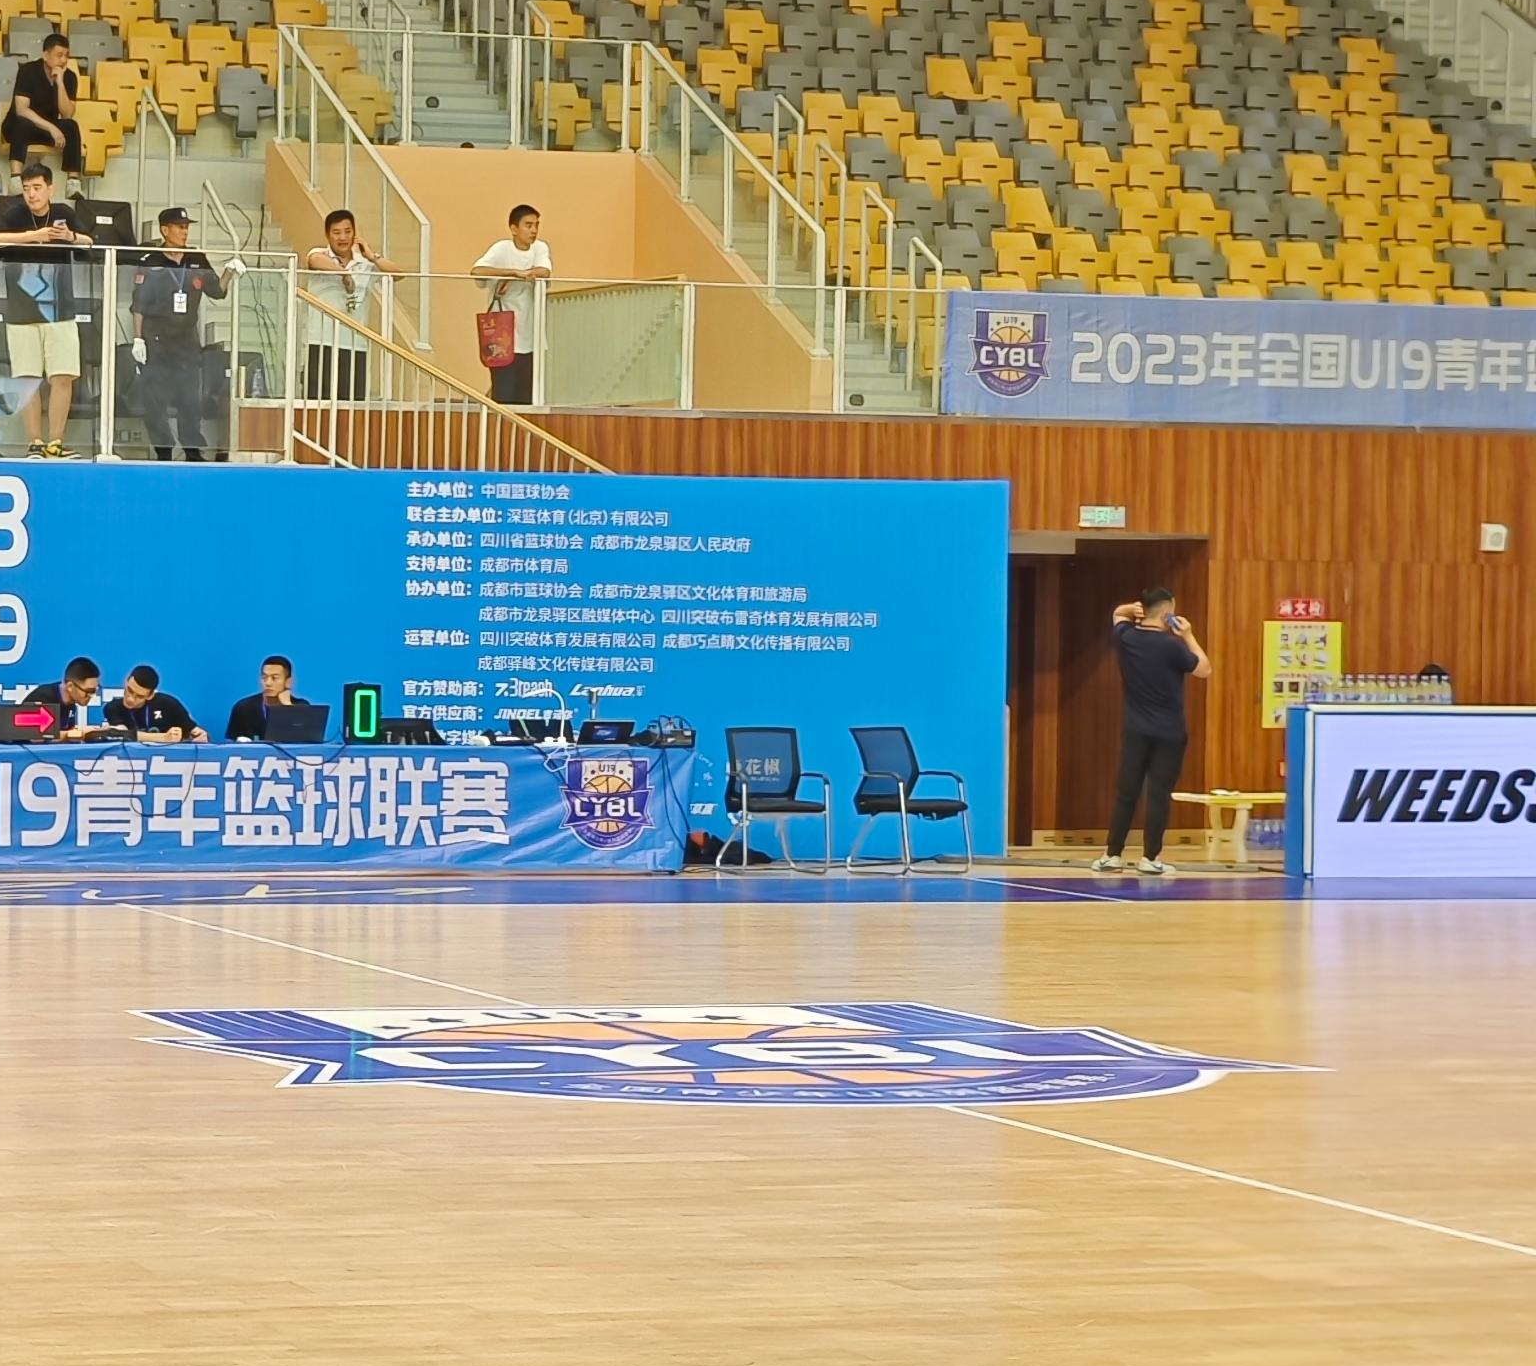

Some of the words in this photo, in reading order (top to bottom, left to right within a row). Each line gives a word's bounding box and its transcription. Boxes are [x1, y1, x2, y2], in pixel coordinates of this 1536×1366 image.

[979, 345, 1041, 368] CYBL
[574, 796, 643, 817] CYBL
[1336, 768, 1536, 824] WEEDS
